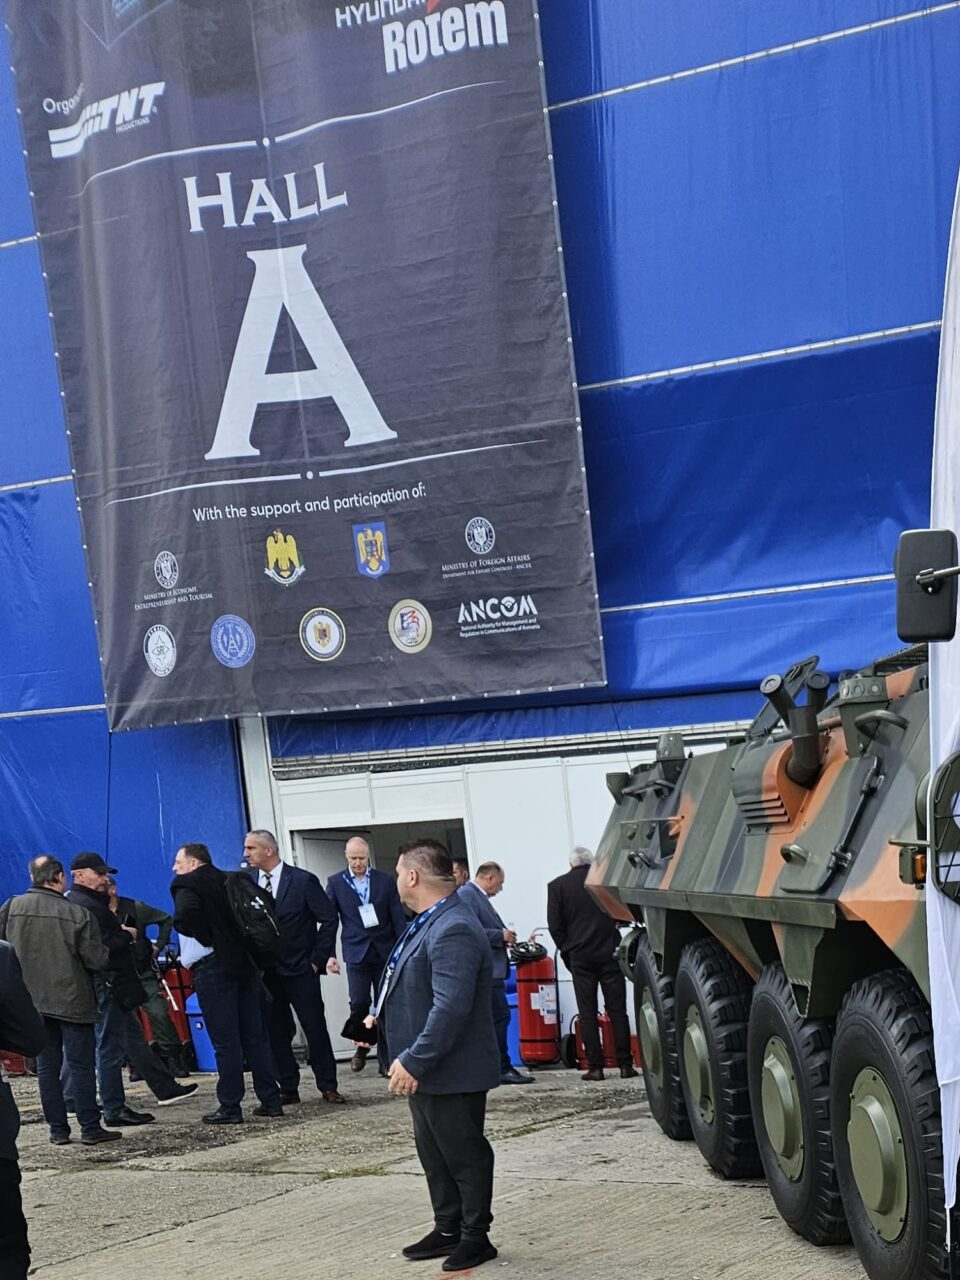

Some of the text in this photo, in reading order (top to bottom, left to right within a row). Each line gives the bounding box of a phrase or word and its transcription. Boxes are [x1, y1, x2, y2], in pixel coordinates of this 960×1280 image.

[382, 0, 508, 74] Rotem
[183, 162, 348, 233] HALL
[204, 243, 399, 461] A
[193, 481, 427, 522] With the support and participation of:
[441, 554, 531, 571] MINISTRY OF FOREIGN AFFAIRS
[143, 592, 166, 600] MINISTRY
[458, 594, 538, 623] ANCOM
